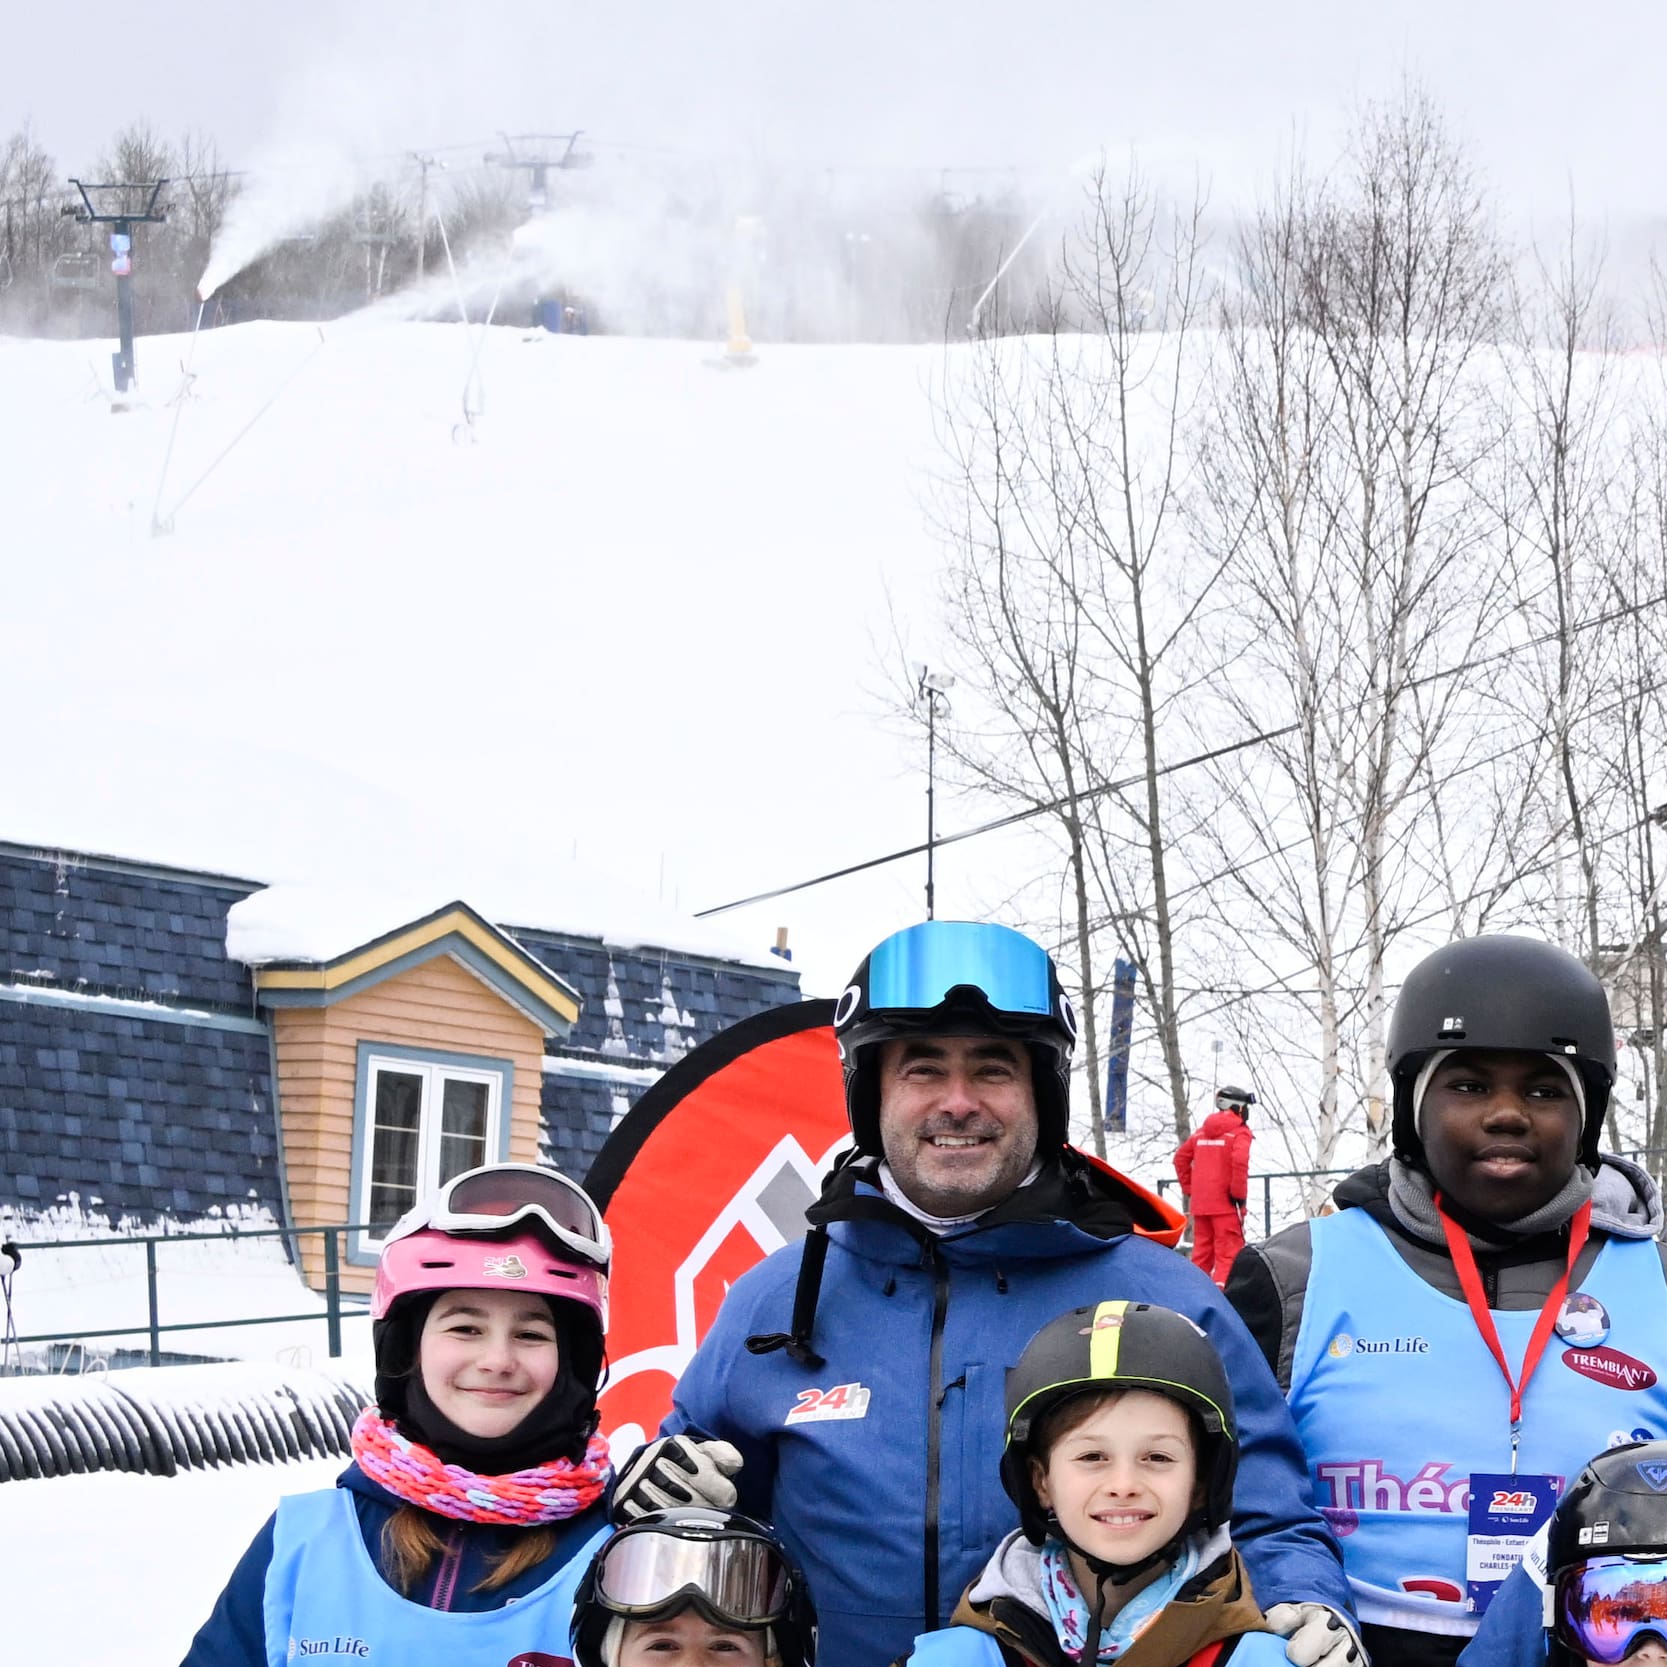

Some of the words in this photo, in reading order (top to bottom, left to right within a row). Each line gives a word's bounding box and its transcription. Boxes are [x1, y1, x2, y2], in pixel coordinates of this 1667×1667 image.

[1356, 1338, 1391, 1354] Sun
[1394, 1337, 1429, 1354] Life
[1571, 1353, 1650, 1387] TREMBLANT
[791, 1384, 869, 1415] 24h
[1492, 1492, 1535, 1507] 24h
[1492, 1553, 1523, 1562] FONDATI
[300, 1637, 332, 1657] Sun
[334, 1637, 370, 1658] Life
